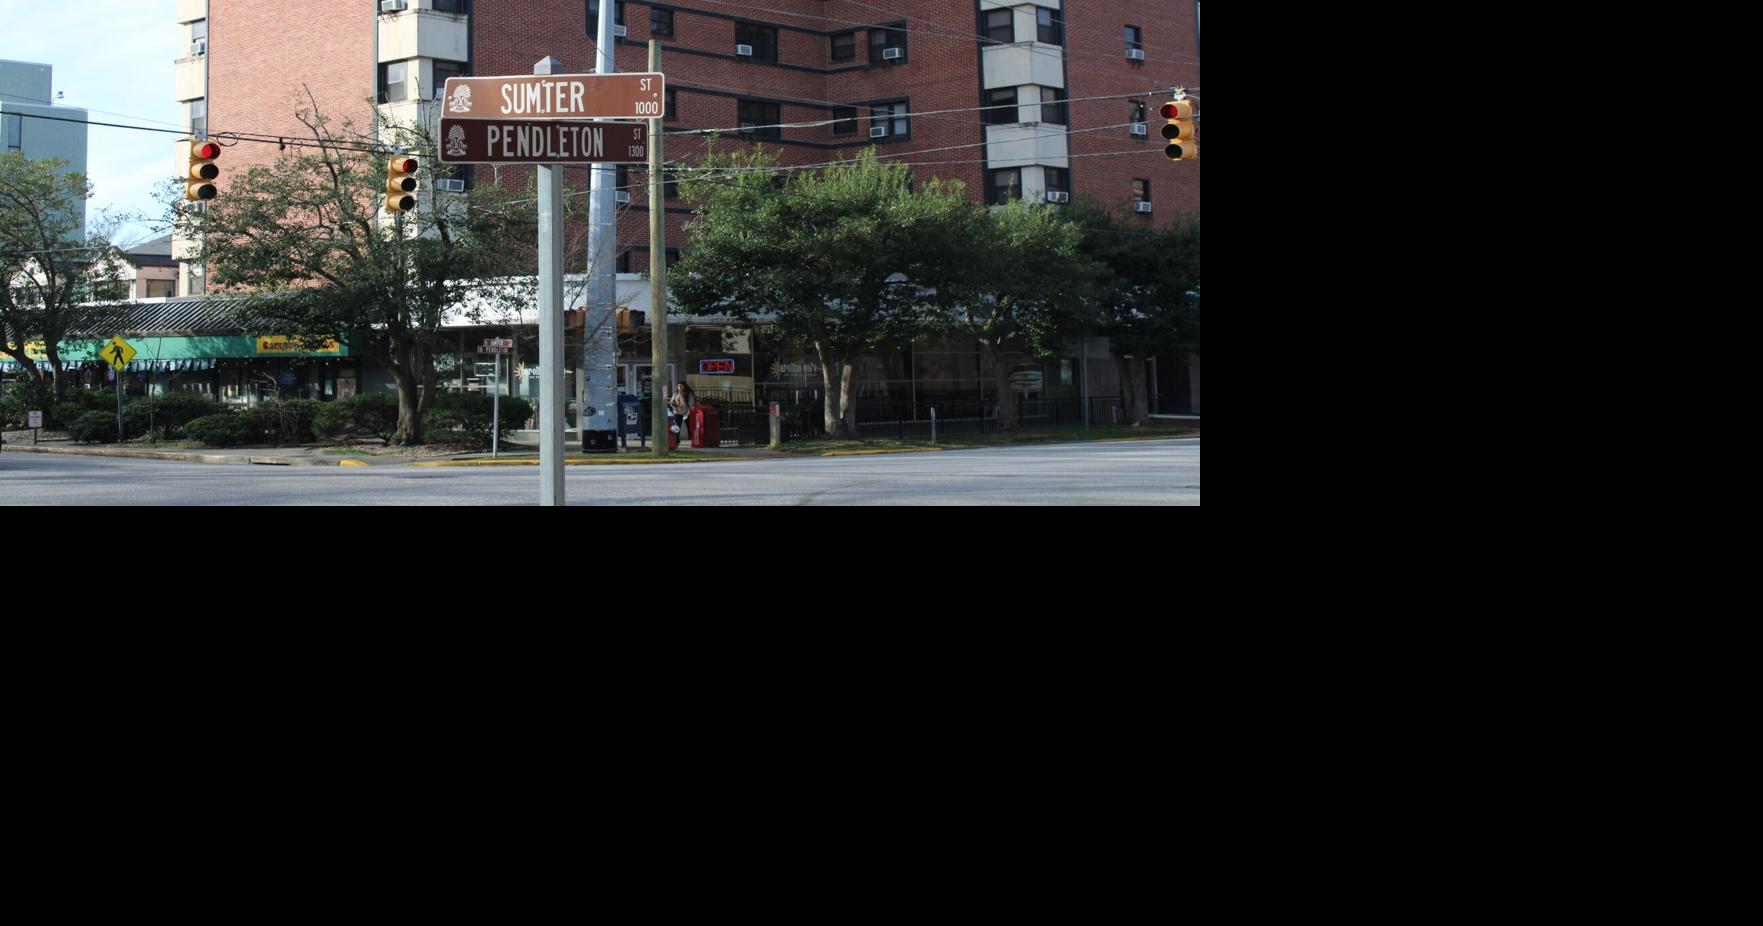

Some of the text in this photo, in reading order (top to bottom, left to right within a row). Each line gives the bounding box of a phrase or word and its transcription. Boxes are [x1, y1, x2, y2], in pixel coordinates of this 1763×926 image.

[640, 78, 652, 91] ST
[500, 81, 585, 114] SUMTER
[635, 101, 659, 115] 1000
[633, 128, 642, 140] ST
[487, 125, 604, 157] PENDLETON
[628, 145, 644, 158] 1300
[703, 361, 733, 372] OPEN
